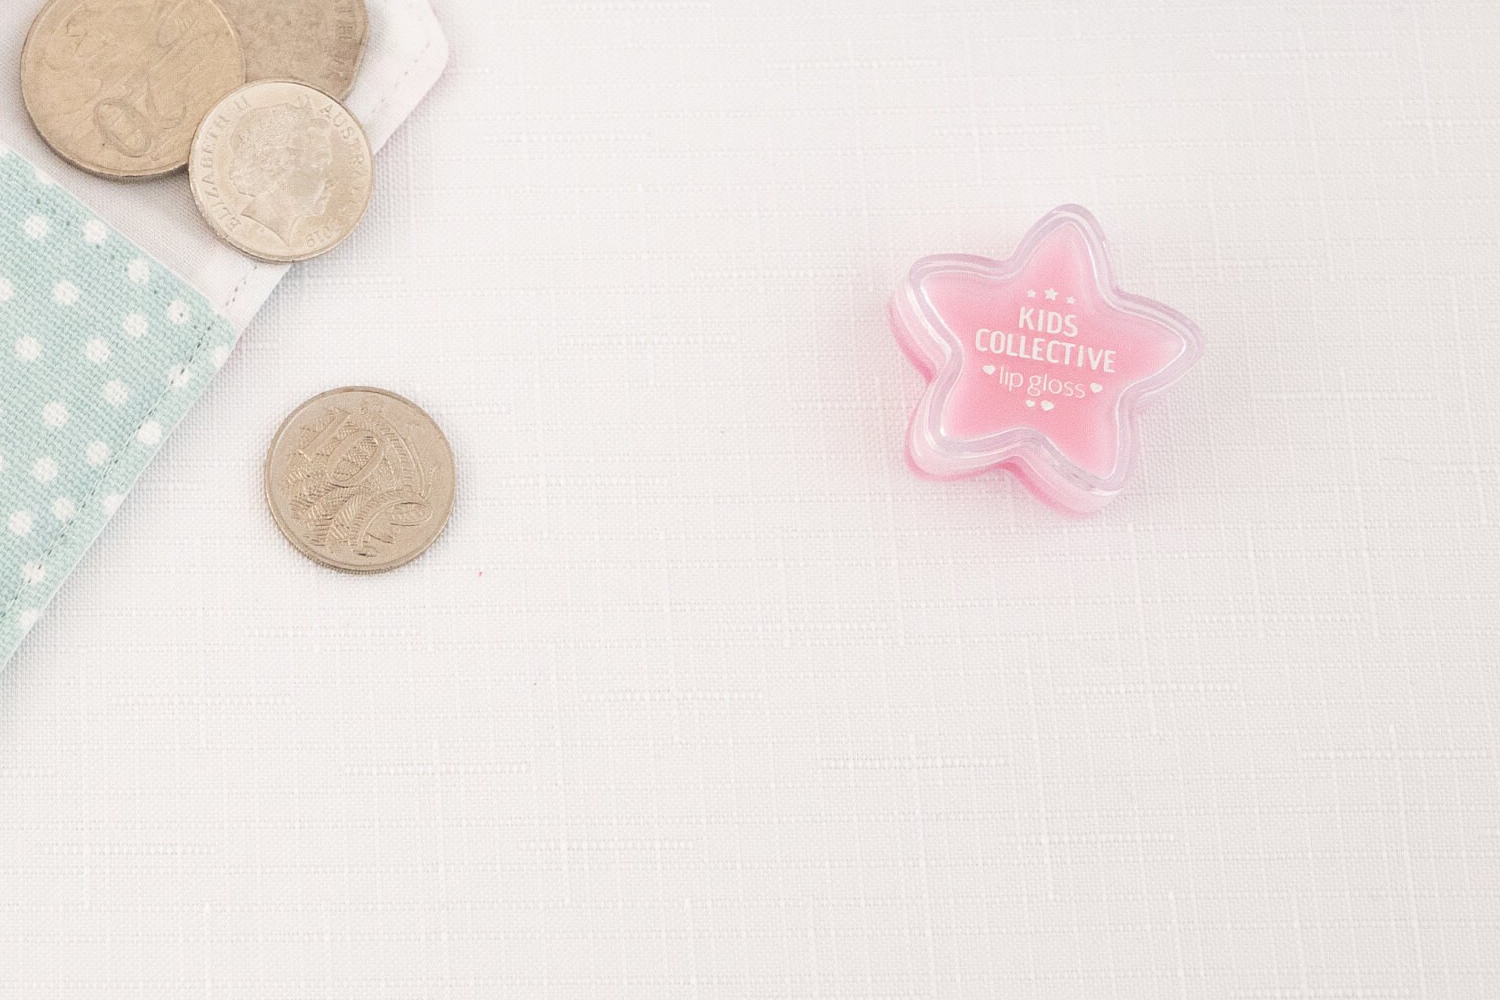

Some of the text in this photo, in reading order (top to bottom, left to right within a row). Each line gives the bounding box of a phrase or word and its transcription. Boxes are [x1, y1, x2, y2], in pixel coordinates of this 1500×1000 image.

[1018, 306, 1078, 338] KIDS
[975, 328, 1117, 374] COLLECTIVE
[999, 366, 1086, 398] lip gloss
